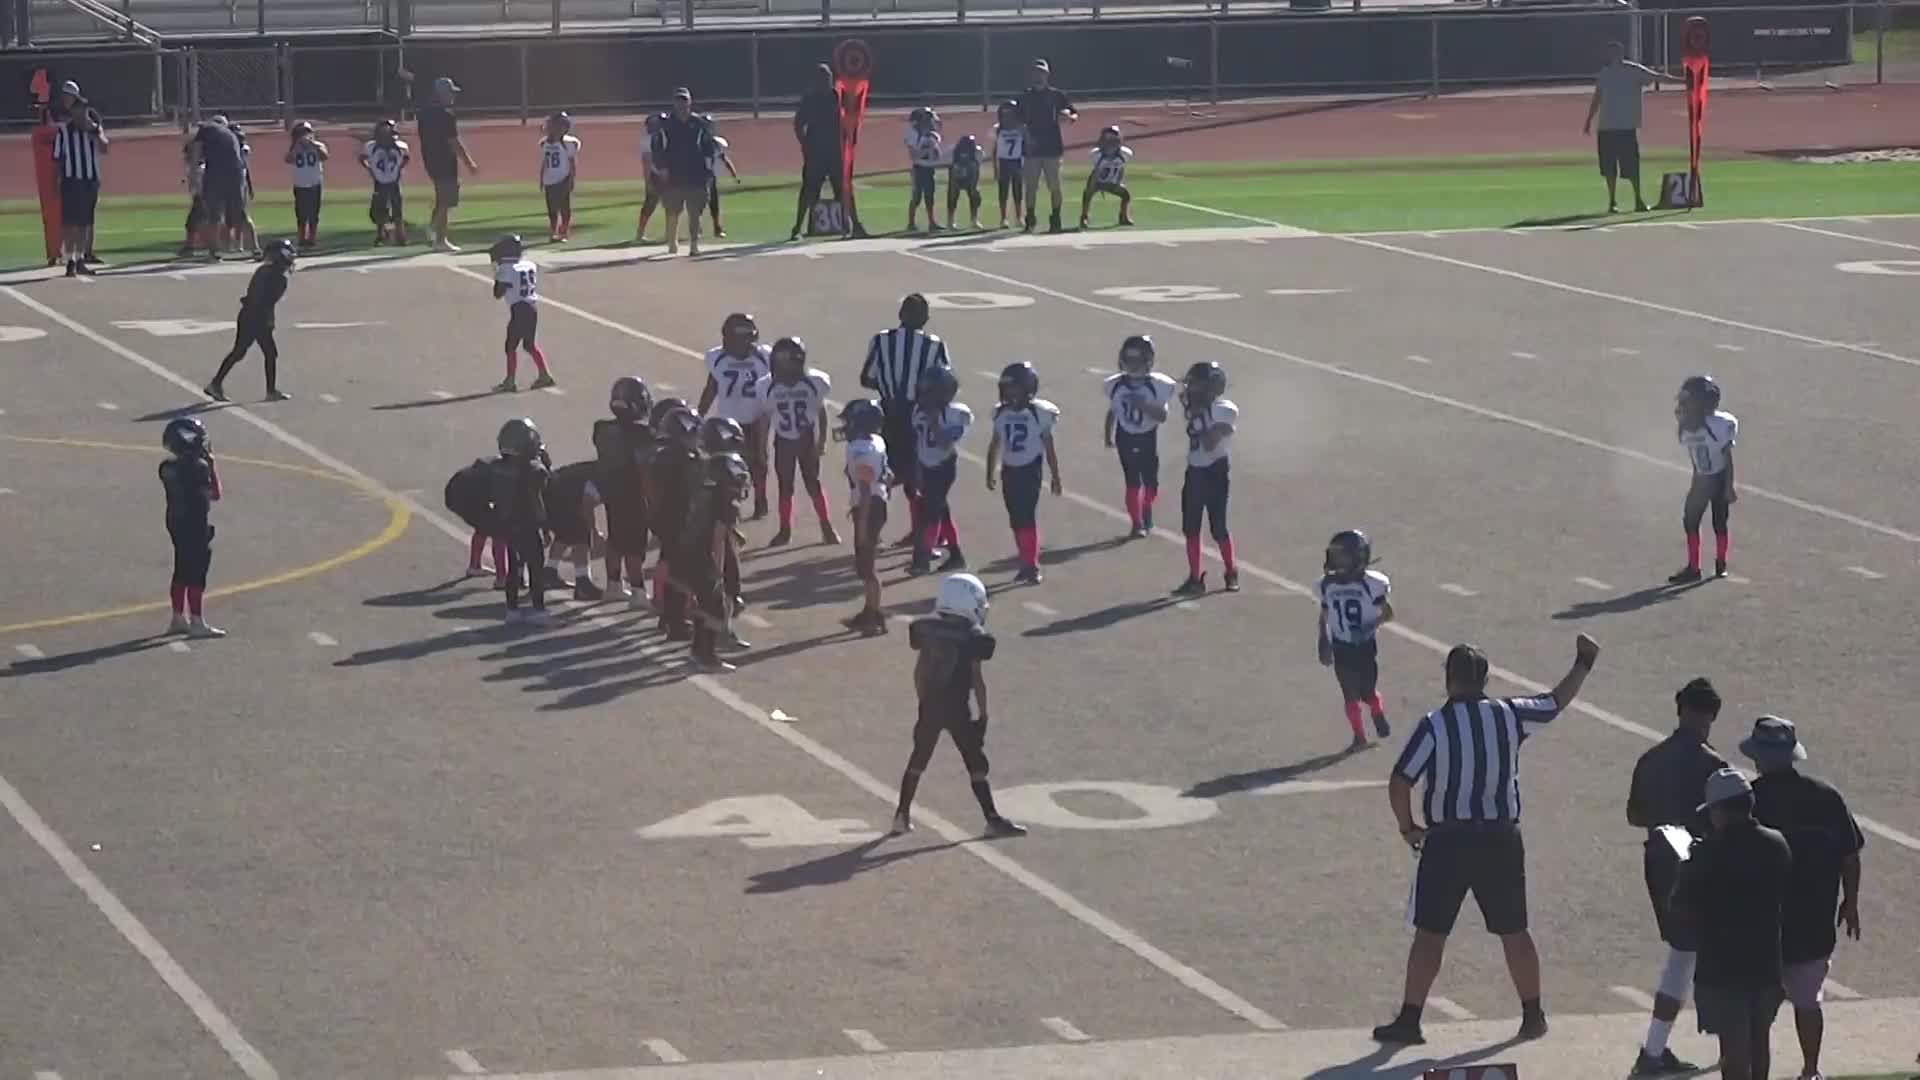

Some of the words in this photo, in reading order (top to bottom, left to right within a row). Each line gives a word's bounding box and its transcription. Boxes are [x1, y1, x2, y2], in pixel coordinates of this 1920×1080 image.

[1004, 139, 1017, 157] 7
[723, 369, 758, 398] 72
[1005, 423, 1028, 452] 12
[1332, 599, 1363, 633] 19
